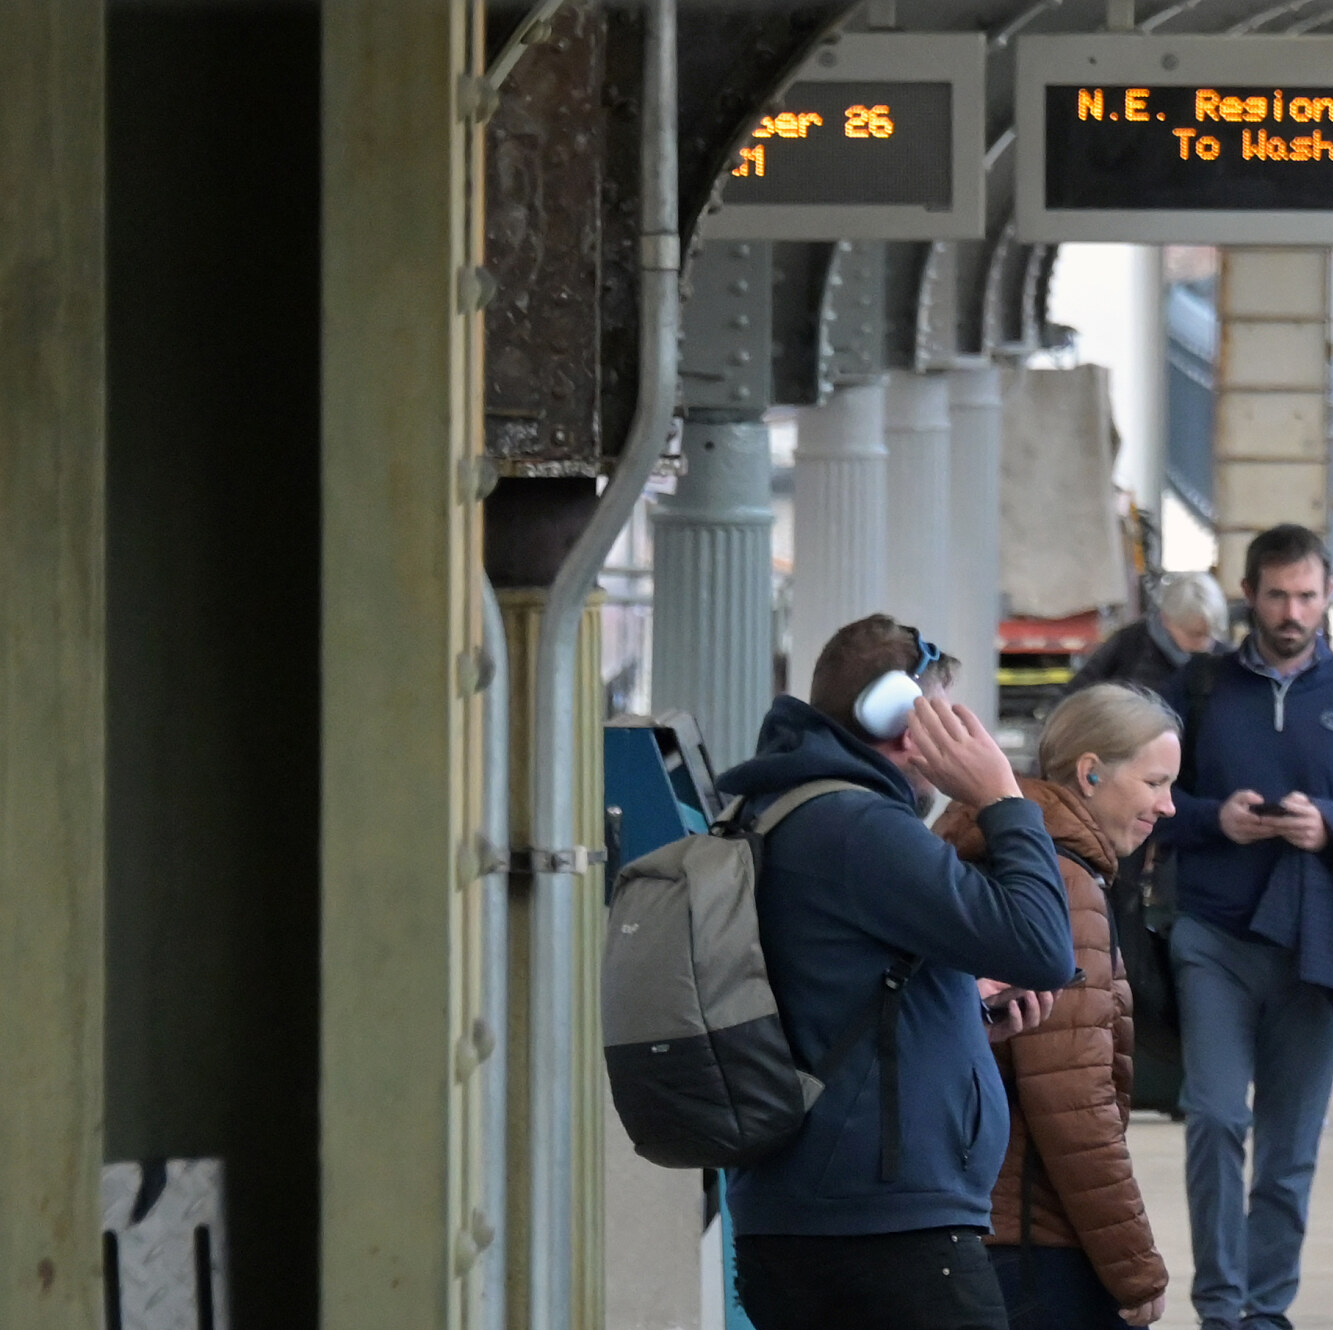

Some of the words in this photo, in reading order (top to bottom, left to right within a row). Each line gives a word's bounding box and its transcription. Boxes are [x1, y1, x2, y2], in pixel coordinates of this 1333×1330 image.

[844, 104, 895, 139] 26
[1077, 88, 1166, 122] N.E.
[1172, 127, 1221, 161] To
